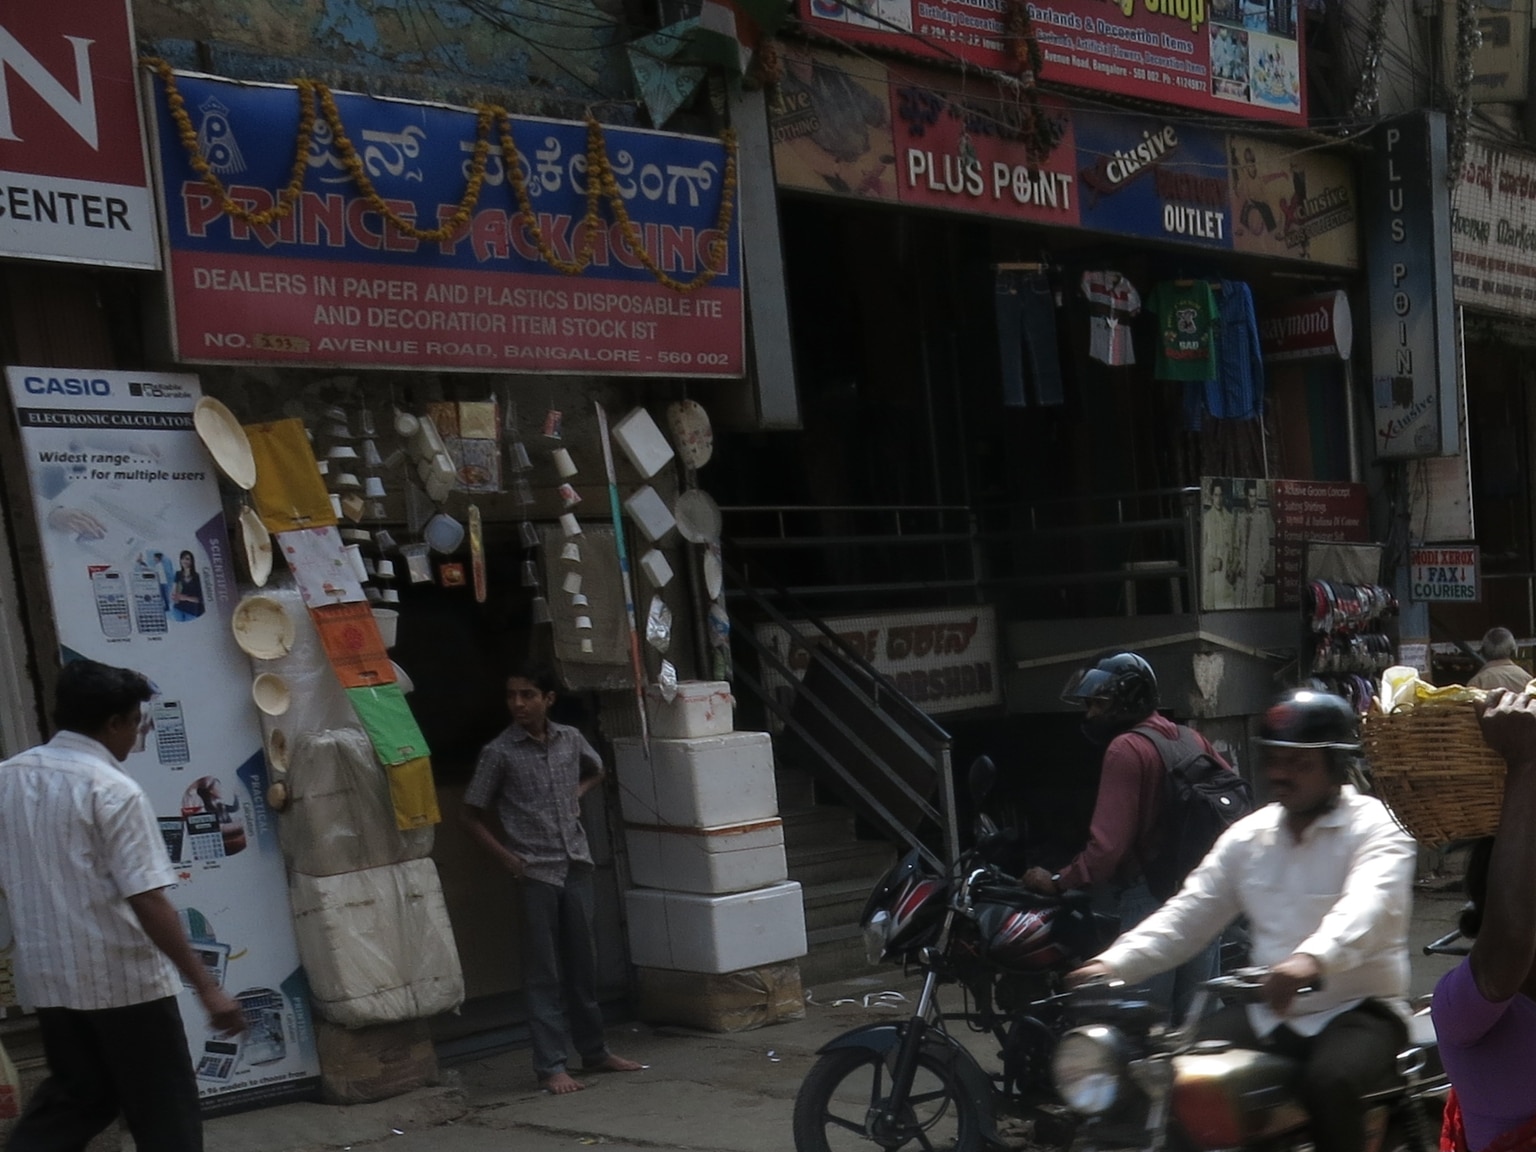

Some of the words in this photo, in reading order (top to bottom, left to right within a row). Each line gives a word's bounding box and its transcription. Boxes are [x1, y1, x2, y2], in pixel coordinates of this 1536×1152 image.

[917, 4, 957, 24] Birthday
[1026, 5, 1083, 31] Garlands
[1084, 17, 1096, 31] &
[1097, 20, 1160, 47] Decoration
[1160, 33, 1195, 55] Items
[771, 116, 818, 143] LOTHING
[907, 148, 985, 198] PLUS
[1387, 128, 1405, 243] PLUS
[0, 186, 132, 232] ENTER
[1163, 203, 1225, 240] OUTLET
[181, 180, 420, 253] PRINCE
[436, 201, 729, 277] PACKAGING
[193, 267, 307, 295] DEALERS
[313, 275, 336, 297] IN
[343, 278, 418, 301] PAPER
[424, 283, 469, 304] AND
[474, 286, 568, 311] PLASTICS
[573, 292, 692, 317] DISPOSABLE
[696, 299, 722, 318] ITE
[313, 303, 362, 327] AND
[512, 315, 558, 337] ITEM
[561, 317, 628, 340] STOCK
[631, 319, 658, 341] IST
[203, 332, 252, 349] NO.
[317, 336, 420, 355] AVENUE
[426, 340, 498, 358] ROAD,
[504, 344, 641, 363] BANGALORE
[657, 350, 692, 364] 560
[696, 352, 729, 366] 002
[23, 375, 111, 397] CASIO
[27, 411, 111, 425] ELECTRONIC
[38, 451, 88, 464] Widest
[90, 453, 131, 466] range
[90, 469, 111, 480] for
[114, 469, 169, 483] multiple
[171, 471, 206, 481] users
[209, 538, 230, 603] SCIENTIFIC
[1413, 550, 1439, 565] MODI
[1440, 550, 1475, 565] XEROX
[1414, 584, 1475, 598] COURIERS
[1428, 567, 1459, 583] FAX
